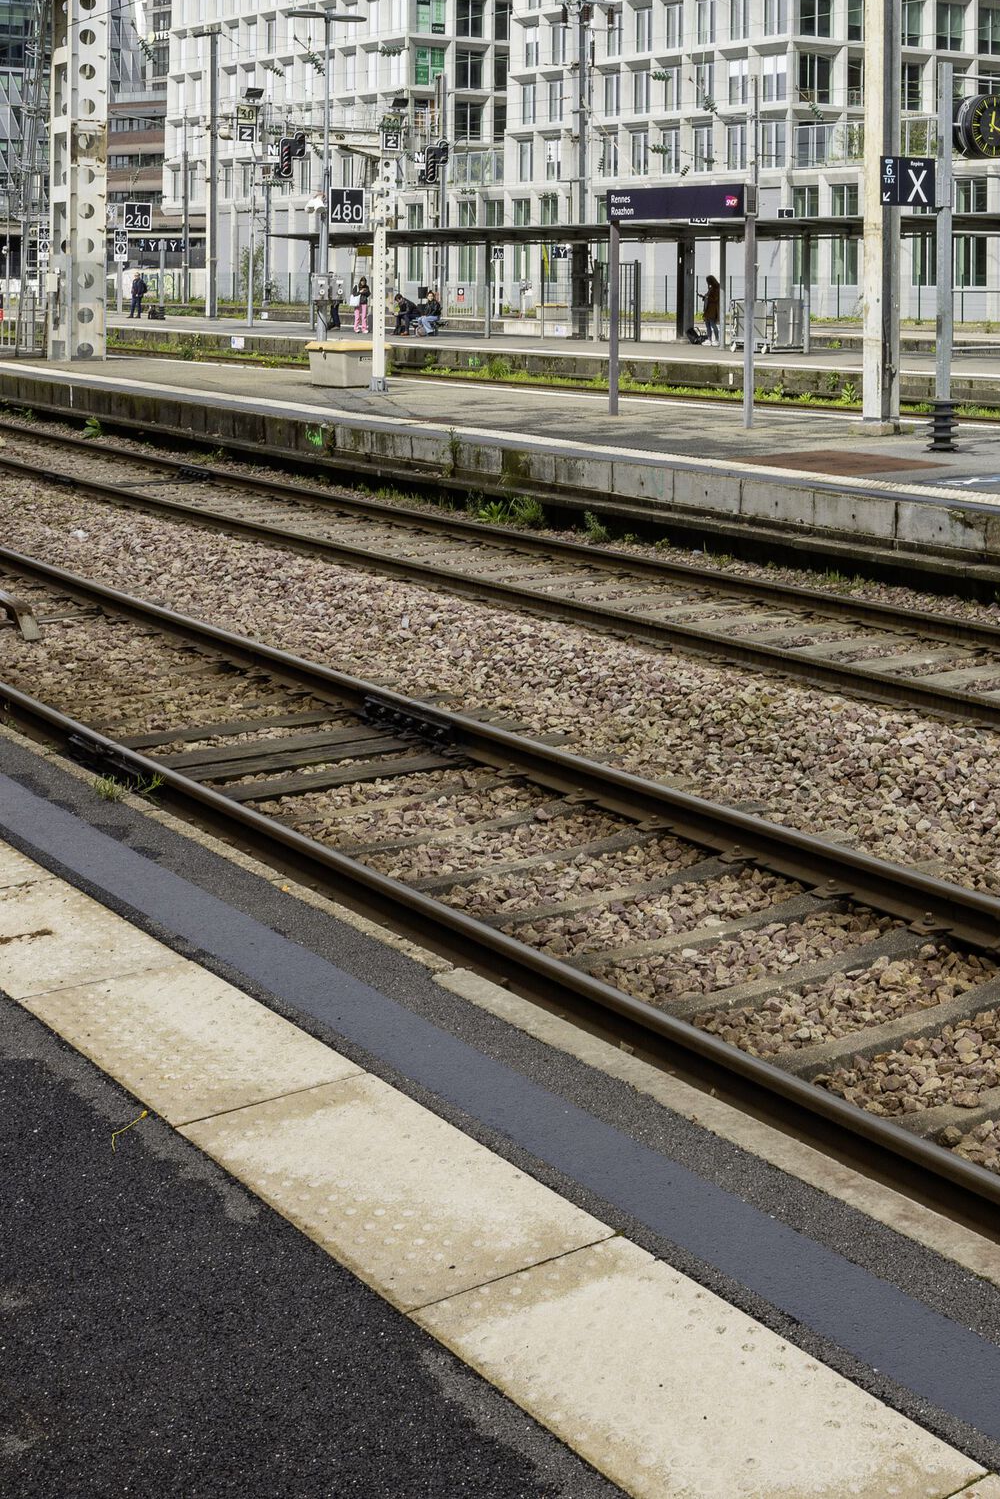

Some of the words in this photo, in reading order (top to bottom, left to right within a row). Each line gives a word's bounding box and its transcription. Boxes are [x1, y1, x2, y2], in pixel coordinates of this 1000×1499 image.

[240, 109, 254, 120] 30
[241, 128, 252, 140] Z
[886, 164, 893, 176] 6
[907, 169, 928, 202] X
[343, 190, 351, 204] L
[610, 195, 631, 204] Rennes
[332, 203, 363, 220] 480
[610, 206, 635, 216] Roazhon
[125, 214, 150, 227] 240
[149, 242, 157, 252] Y
[169, 242, 178, 252] Y
